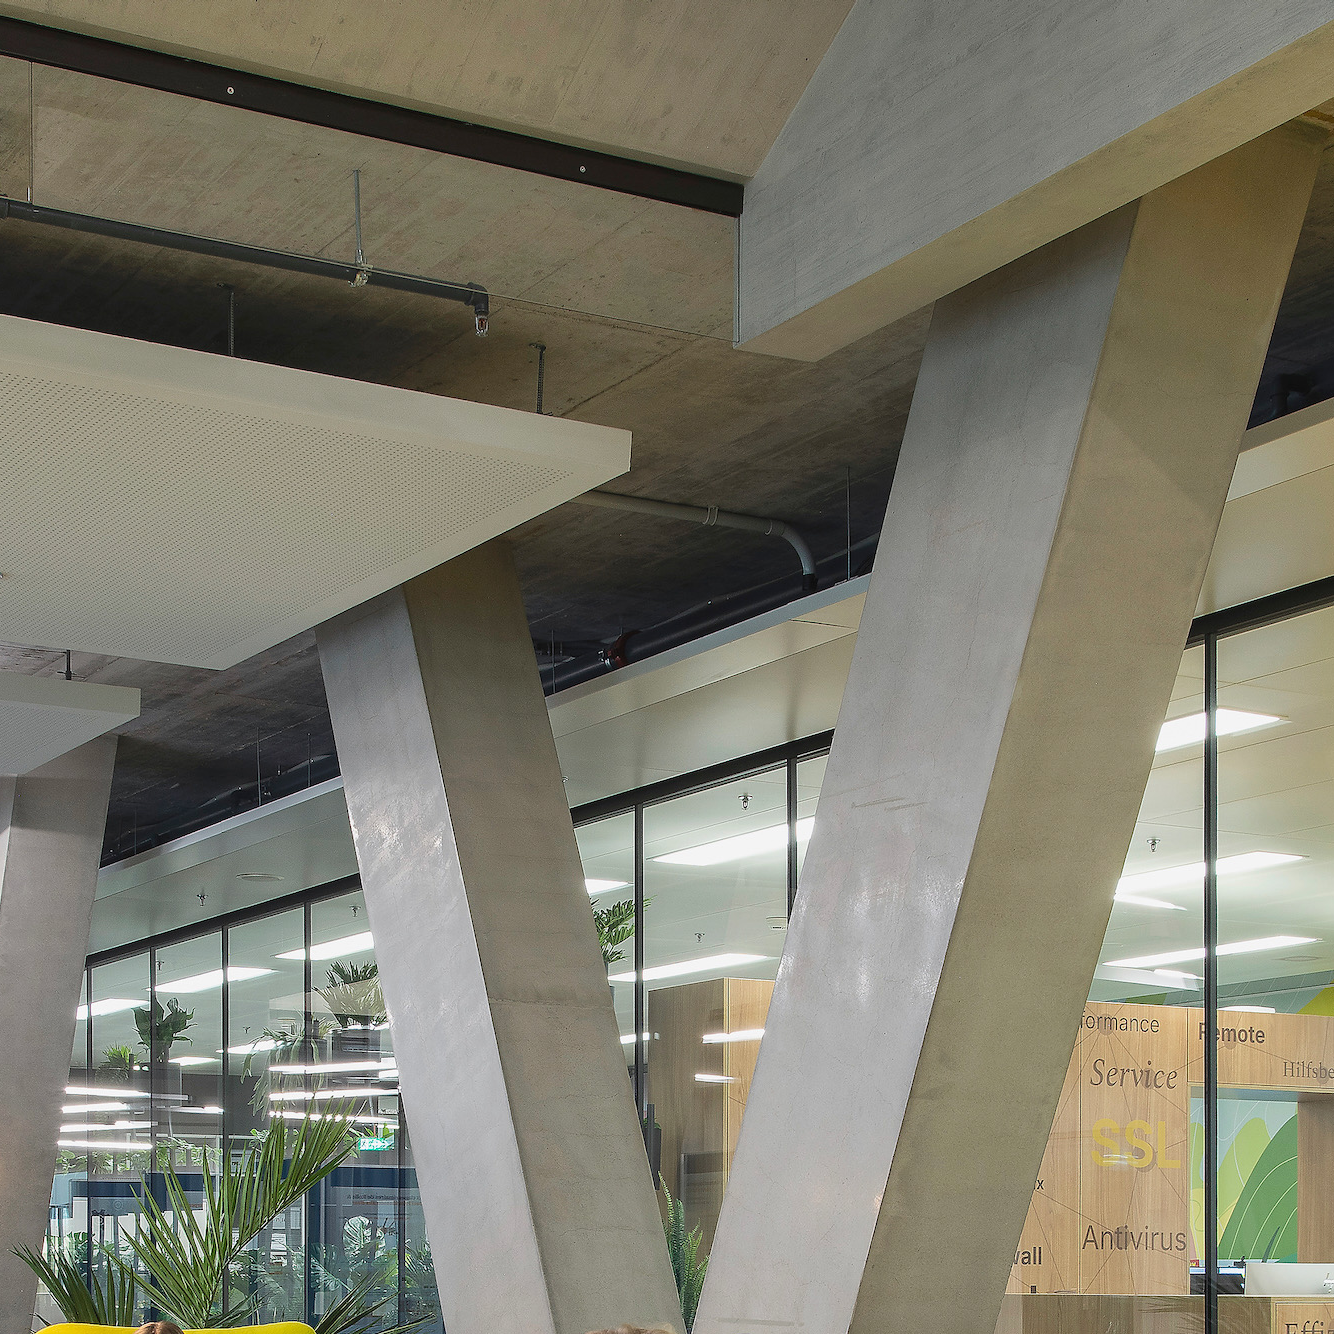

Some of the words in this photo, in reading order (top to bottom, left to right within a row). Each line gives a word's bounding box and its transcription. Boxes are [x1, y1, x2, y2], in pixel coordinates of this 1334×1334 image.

[1090, 1059, 1178, 1090] Service
[1091, 1118, 1181, 1169] SSL
[1082, 1225, 1187, 1251] Antivirus
